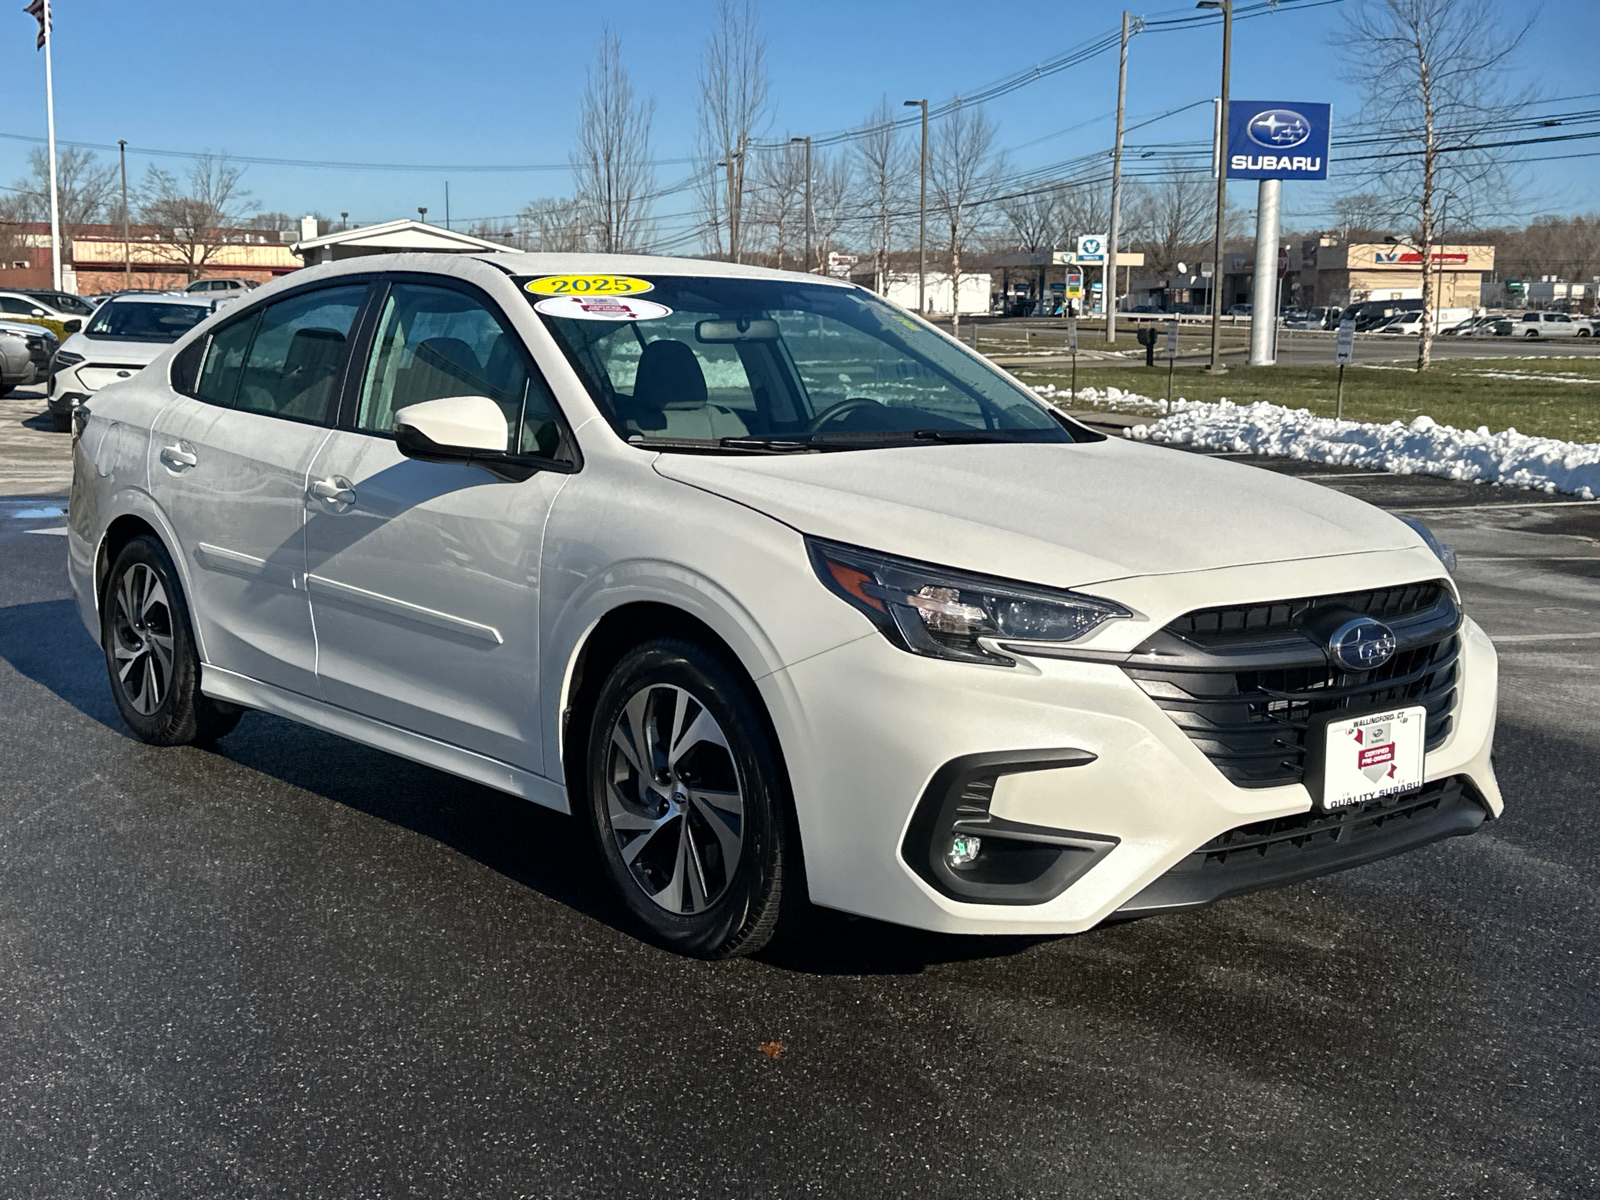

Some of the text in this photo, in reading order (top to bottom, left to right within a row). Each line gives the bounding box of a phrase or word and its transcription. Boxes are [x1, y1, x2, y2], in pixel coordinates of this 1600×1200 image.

[1231, 155, 1321, 171] SUBARU
[551, 278, 632, 293] 2025
[1397, 711, 1405, 719] CT
[1330, 781, 1420, 808] QUALITY SUBARU
